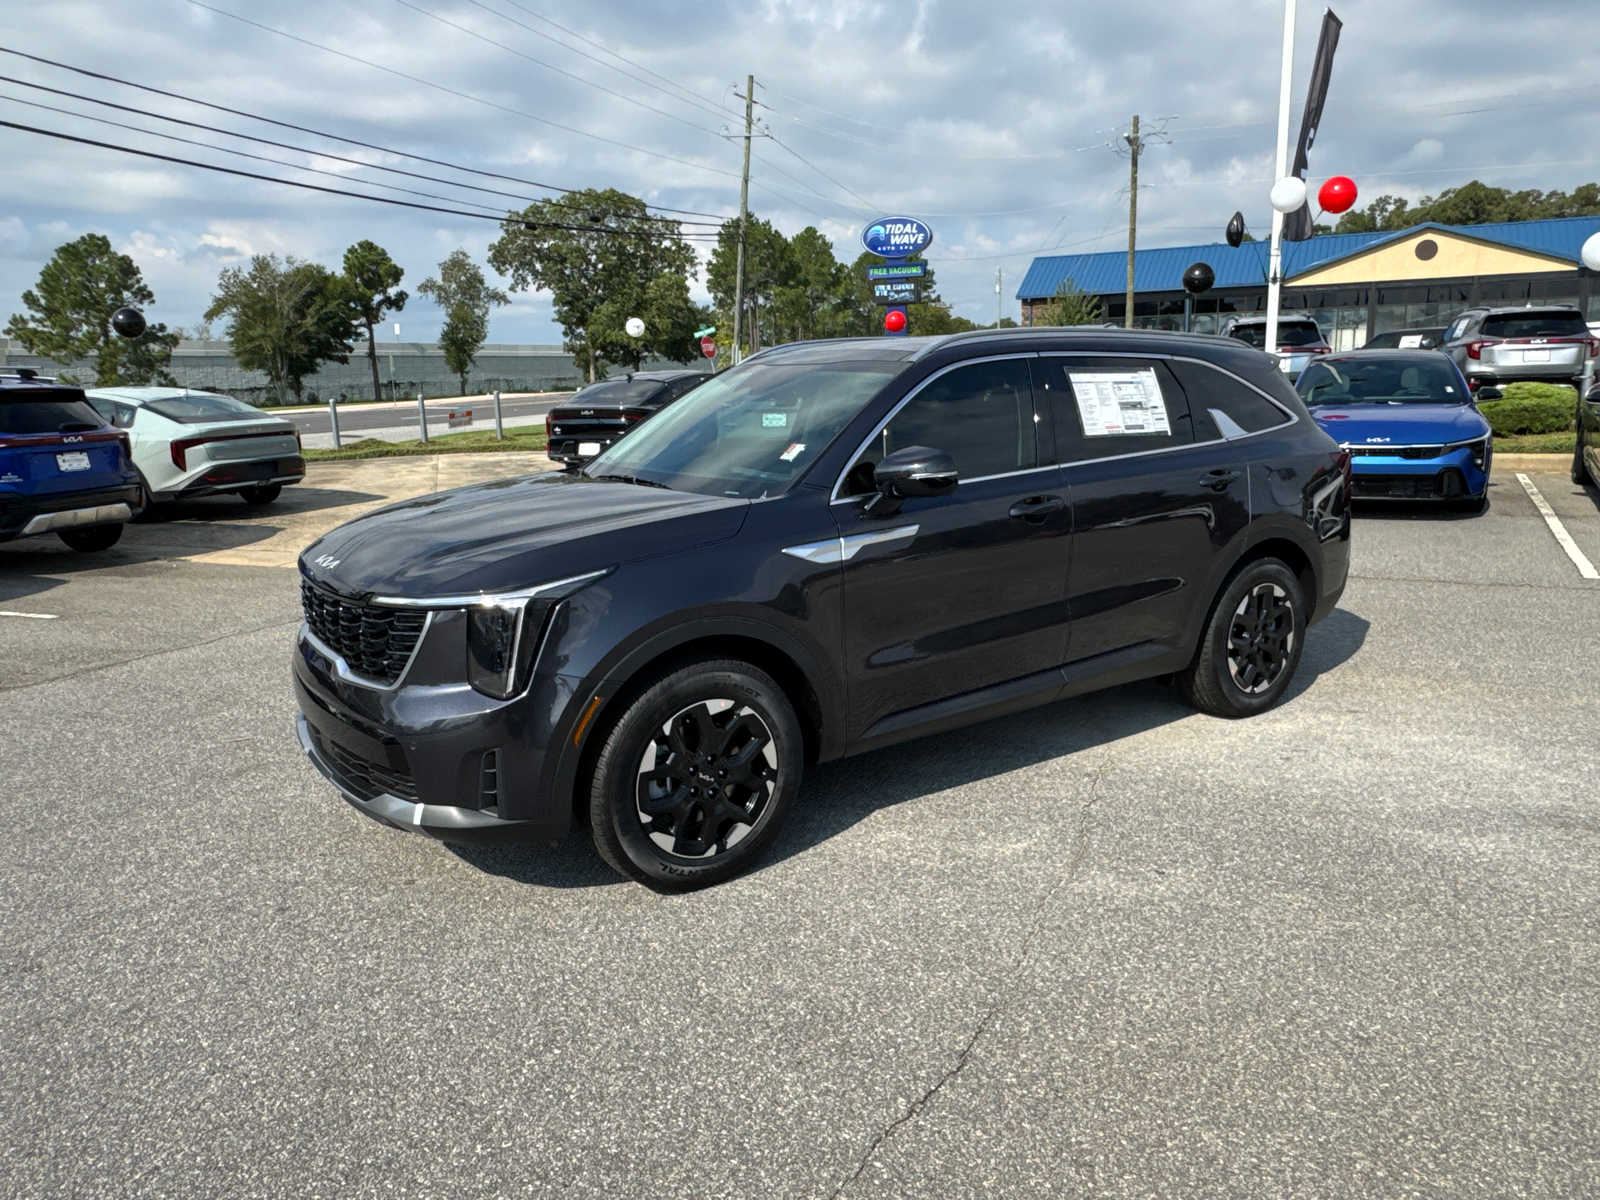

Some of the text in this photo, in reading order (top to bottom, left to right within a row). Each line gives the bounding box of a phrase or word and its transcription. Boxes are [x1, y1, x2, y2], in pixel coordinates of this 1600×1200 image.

[885, 223, 918, 235] TIDAL
[890, 233, 925, 245] WAVE
[869, 266, 922, 276] FREE VACUUMS
[702, 343, 715, 352] STOP
[62, 435, 83, 443] KIA
[314, 553, 340, 569] KIA
